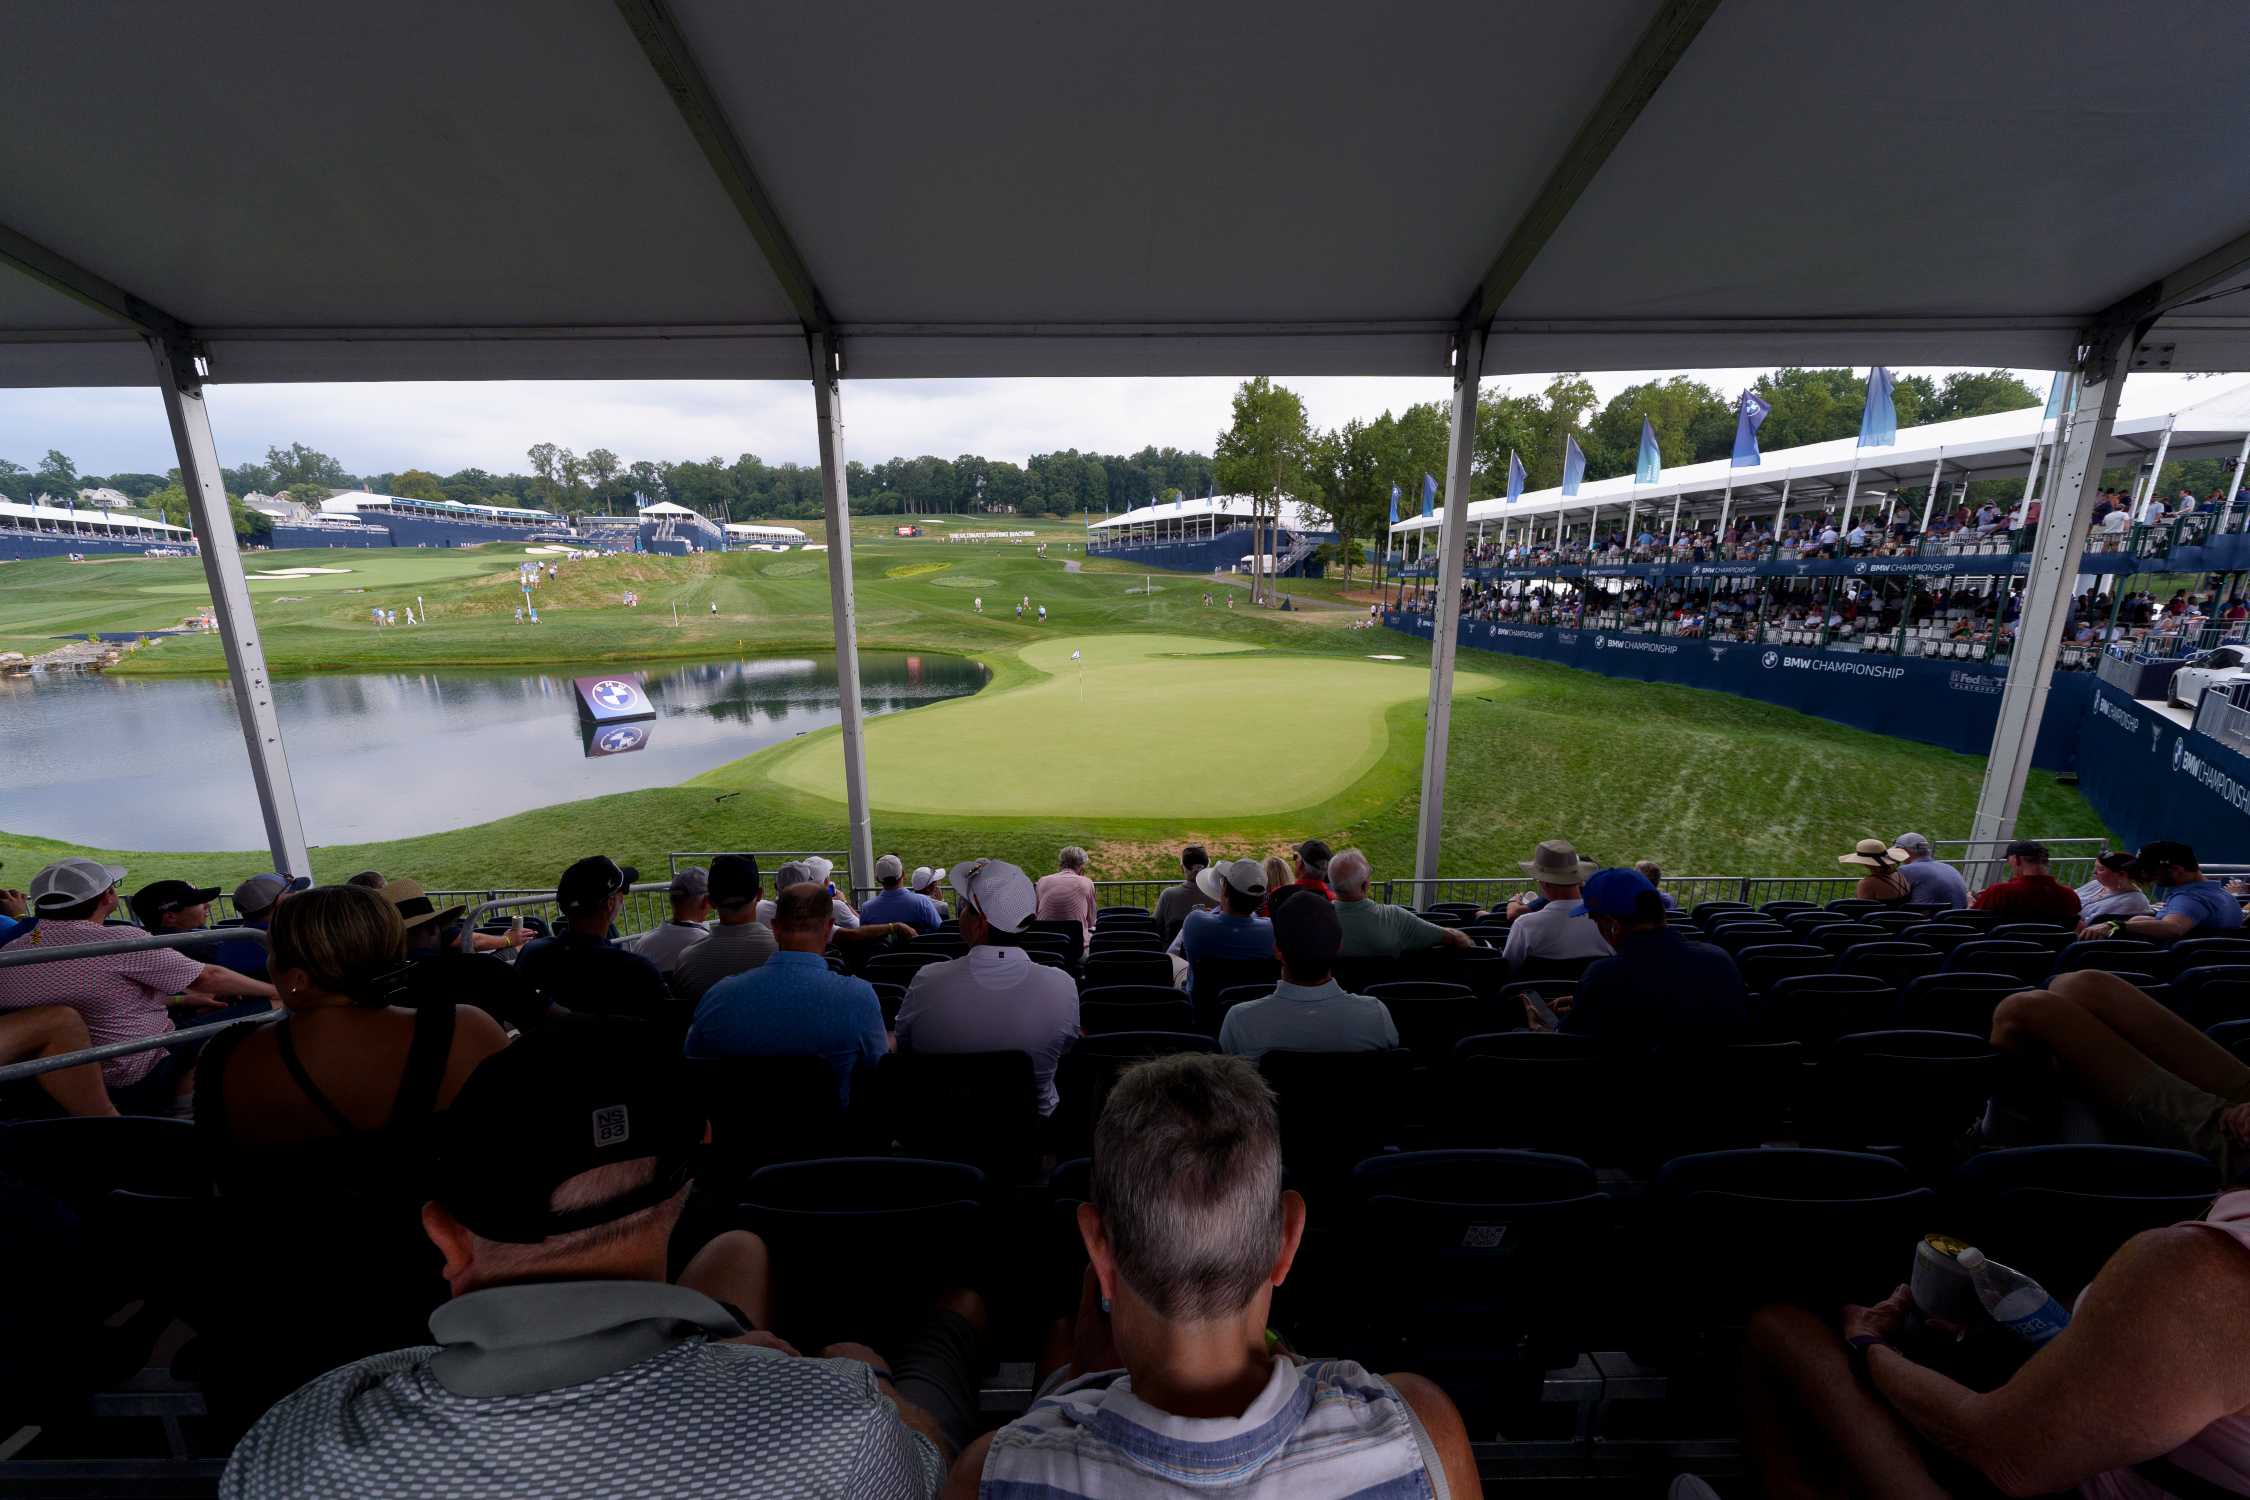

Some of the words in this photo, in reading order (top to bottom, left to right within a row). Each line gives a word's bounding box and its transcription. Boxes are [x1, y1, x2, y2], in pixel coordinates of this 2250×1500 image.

[1715, 566, 1757, 574] CHAMPIONSHIP
[1870, 564, 1891, 573] BMW
[1891, 563, 1955, 573] CHAMPIONSHIP
[1497, 628, 1509, 636] BMW
[1508, 629, 1544, 640] CHAMPIONSHIP
[1607, 639, 1624, 649] BMW
[1624, 642, 1679, 654] CHAMPIONSHIP
[1783, 656, 1811, 669] BMW
[1812, 659, 1905, 679] CHAMPIONSHIP
[2182, 750, 2202, 777] BMW
[2199, 760, 2250, 816] CHAMPIONSHI
